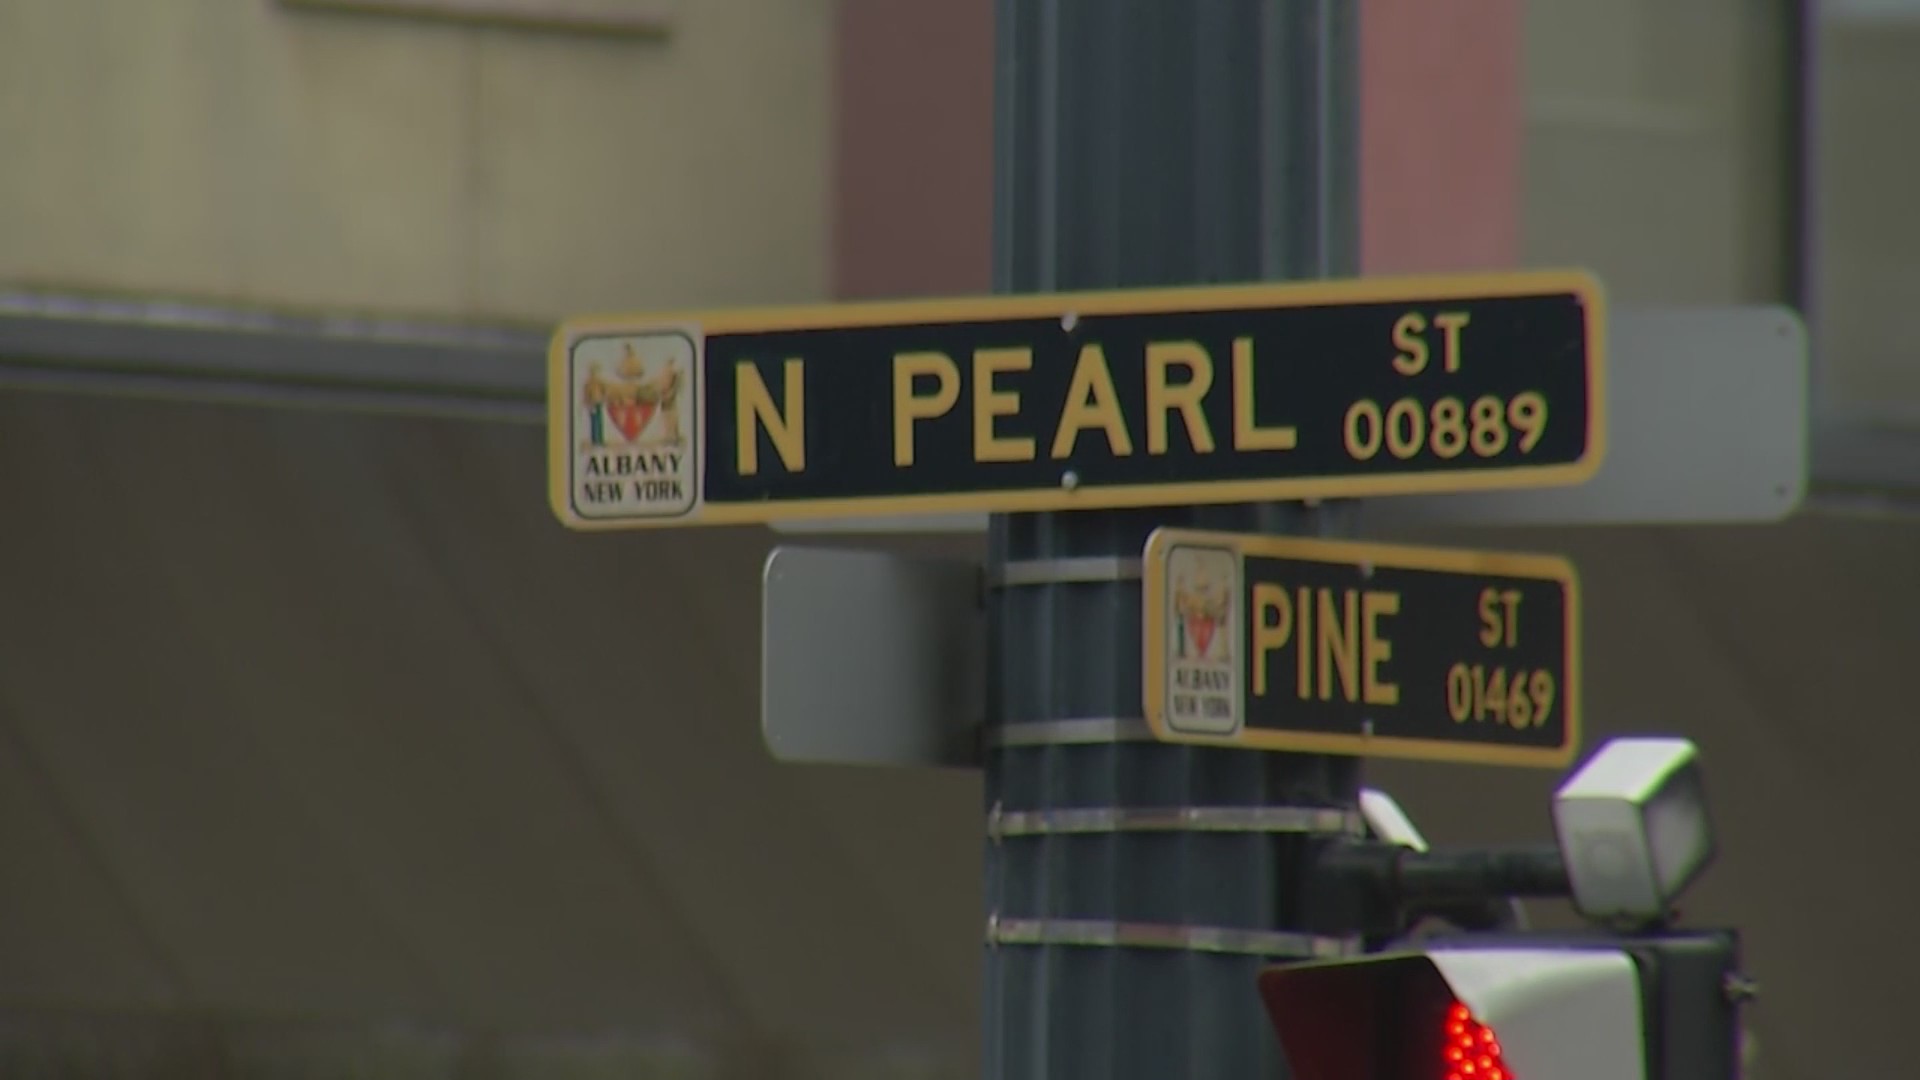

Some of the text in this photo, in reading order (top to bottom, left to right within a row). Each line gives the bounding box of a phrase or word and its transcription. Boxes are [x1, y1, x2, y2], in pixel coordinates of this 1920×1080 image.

[1392, 312, 1470, 376] ST
[735, 337, 1297, 476] N PEARL
[1343, 391, 1549, 460] 00889
[584, 480, 683, 502] NEW YORK
[586, 453, 682, 476] ALBANY
[1252, 583, 1401, 705] PINE
[1477, 588, 1523, 649] ST
[1447, 662, 1555, 729] 01469
